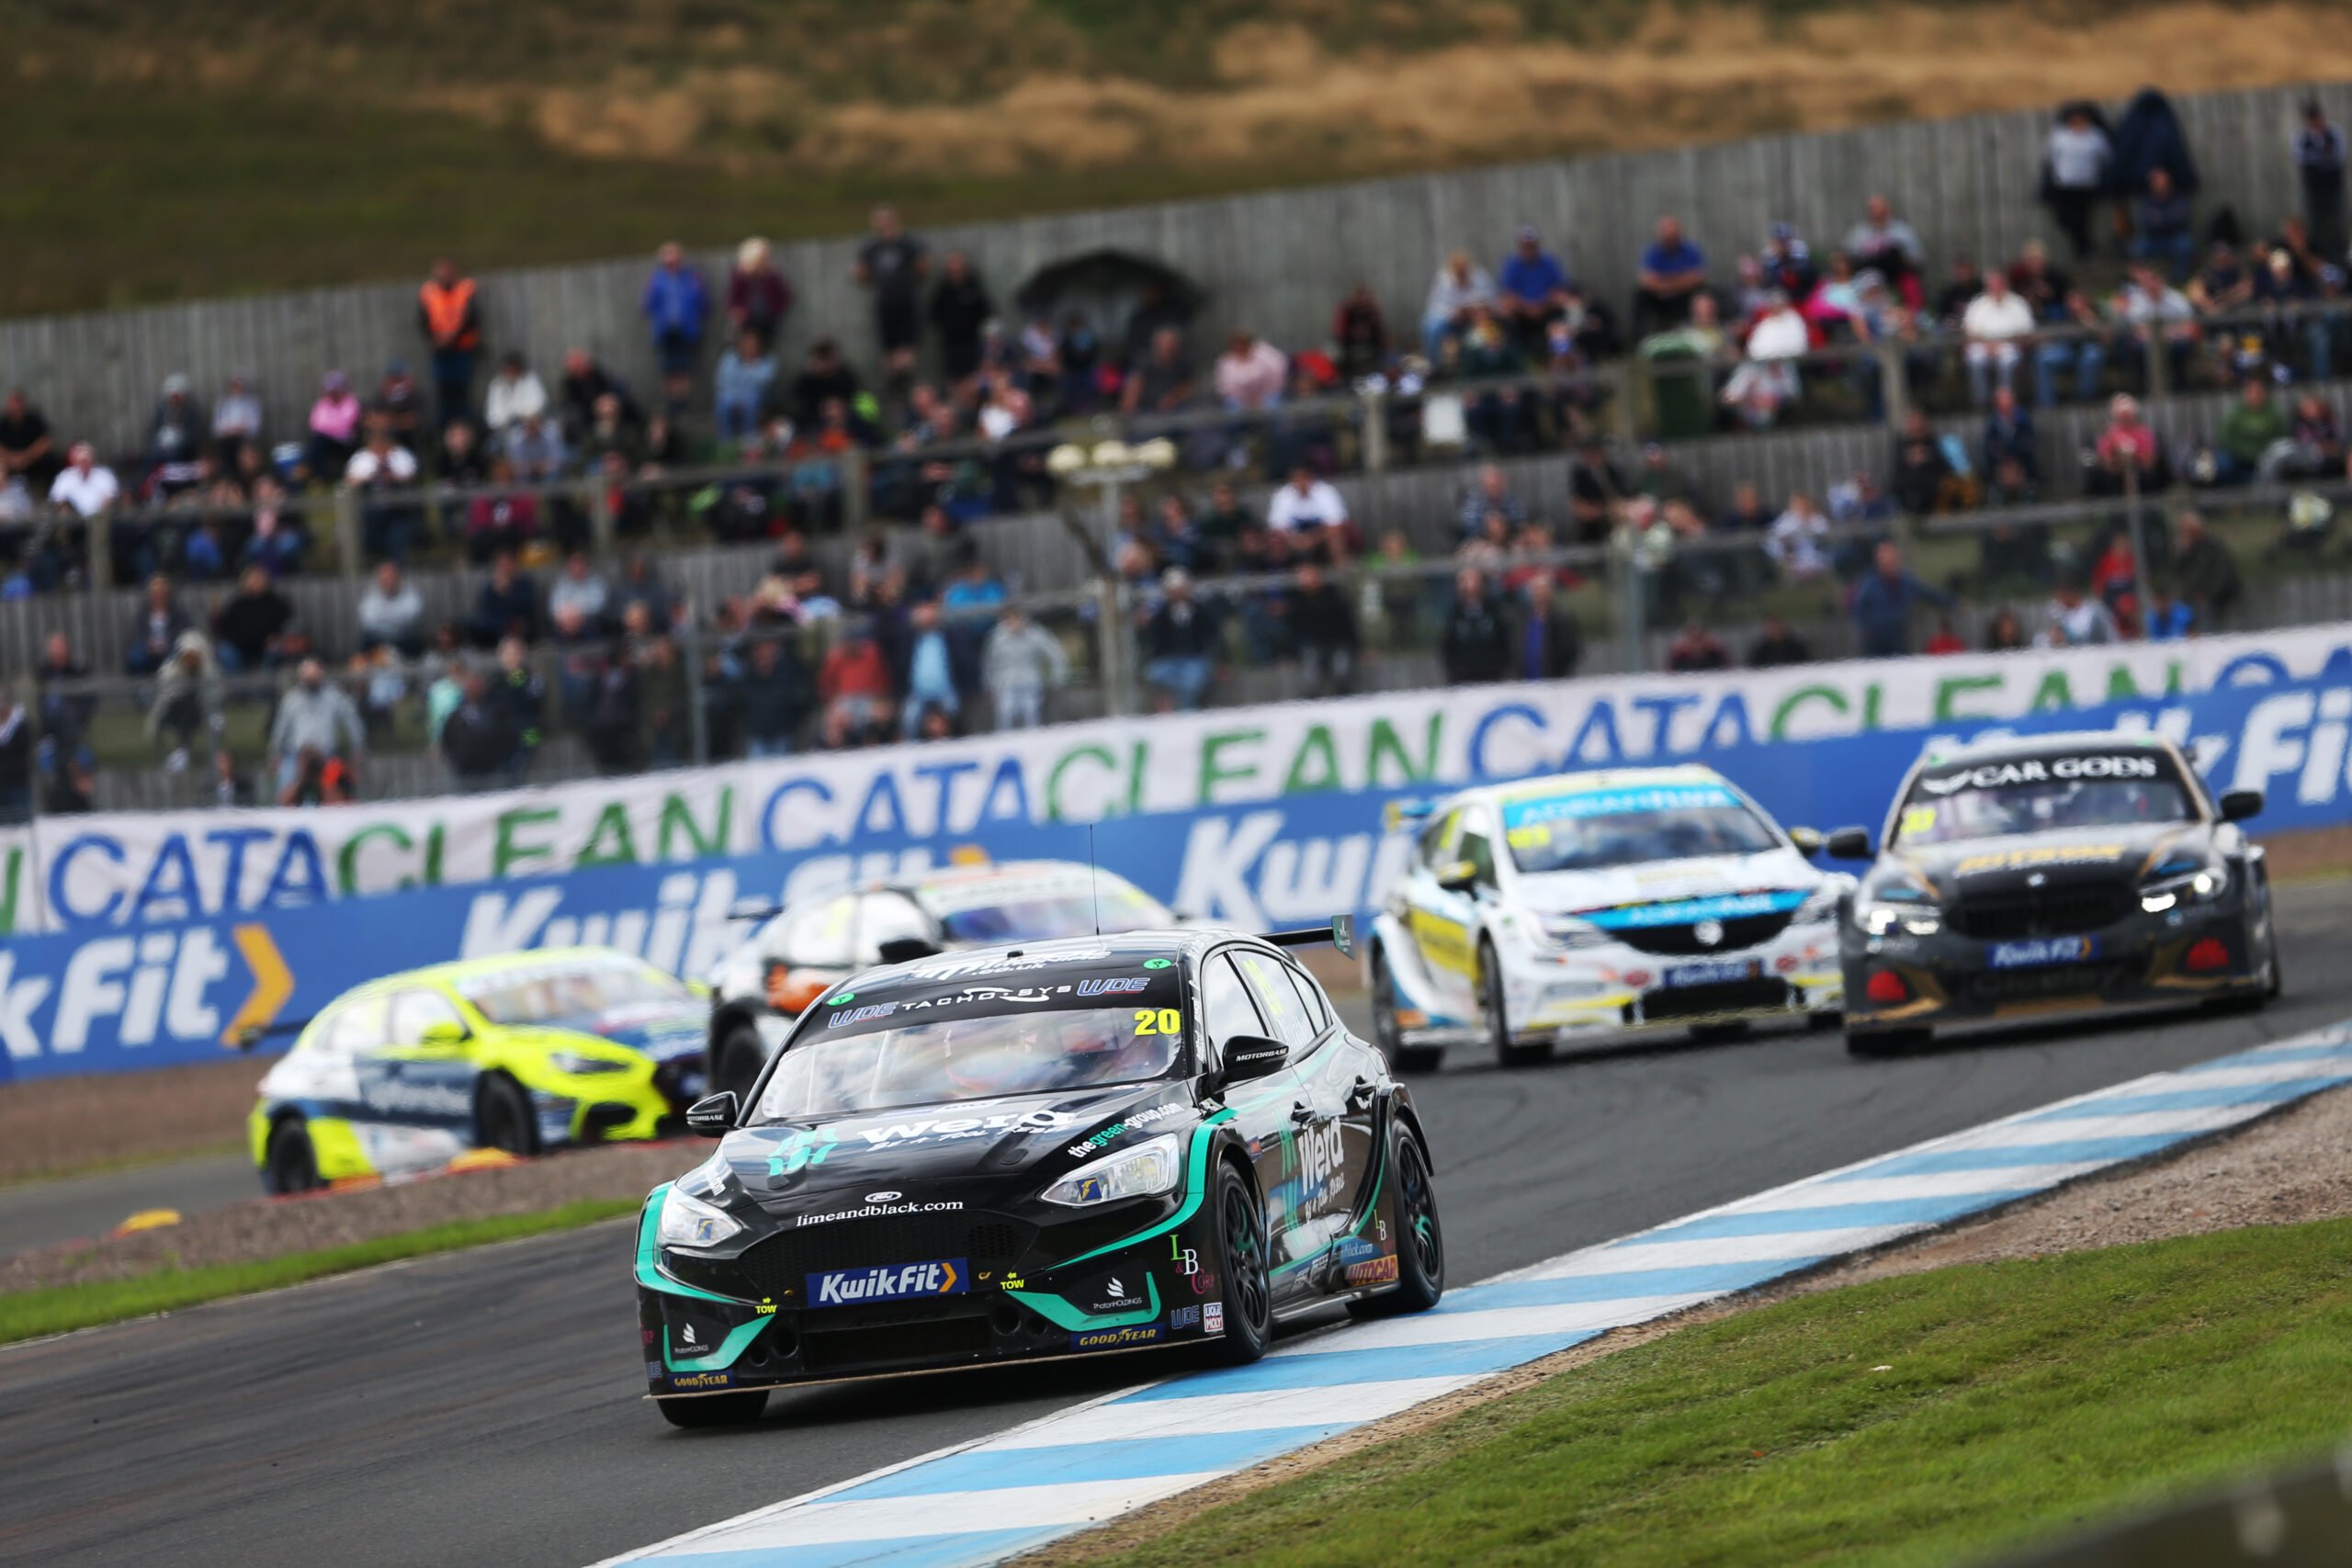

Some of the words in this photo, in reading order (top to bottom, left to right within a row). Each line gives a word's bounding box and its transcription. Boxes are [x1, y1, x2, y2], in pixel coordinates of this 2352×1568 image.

[1973, 766, 2047, 787] CAR
[2052, 756, 2156, 778] GODS
[828, 1001, 899, 1029] WDE
[1077, 976, 1151, 998] WDE
[1133, 1008, 1182, 1036] 20
[1297, 1114, 1344, 1197] Wera
[796, 1200, 965, 1227] limeandblack.com
[1001, 1279, 1025, 1291] TOW
[754, 1304, 777, 1314] TOW
[1170, 1304, 1200, 1330] WDE
[1205, 1304, 1221, 1317] LIQUI
[1205, 1316, 1222, 1331] MOLY
